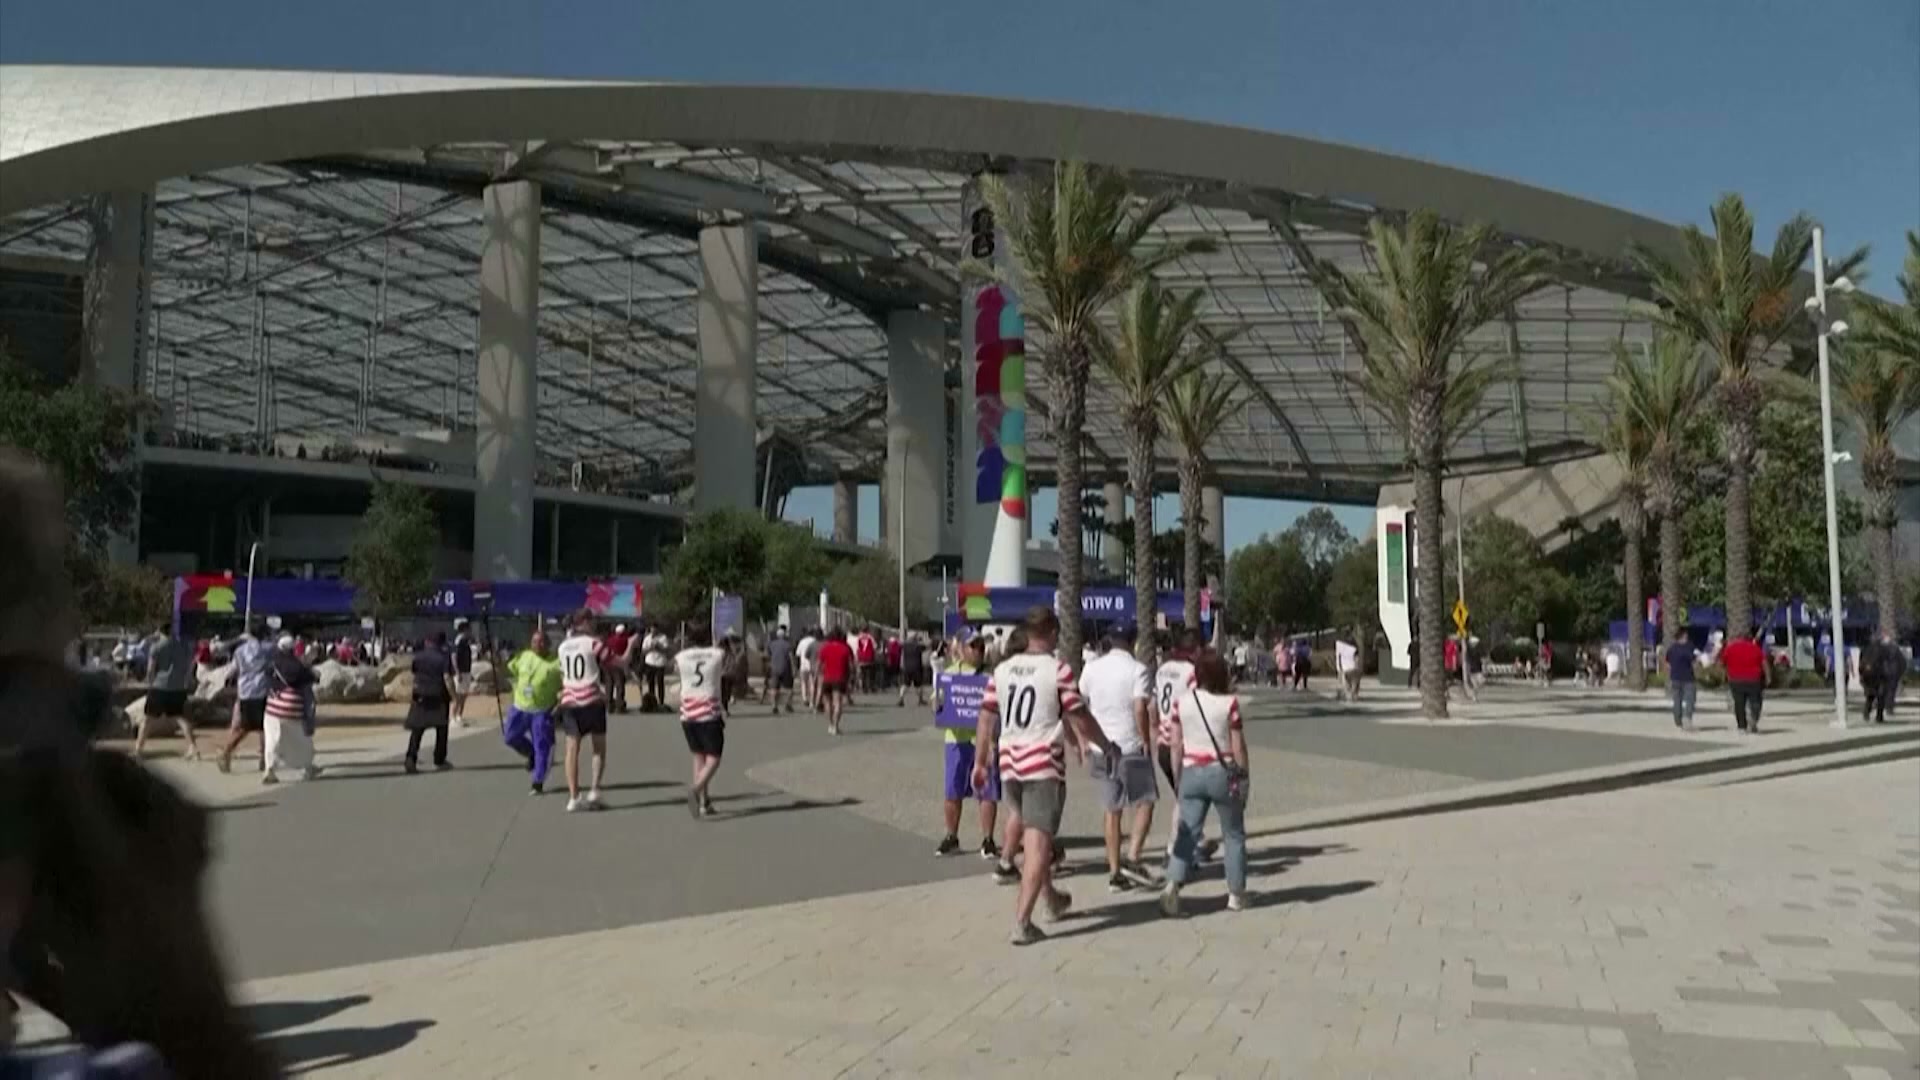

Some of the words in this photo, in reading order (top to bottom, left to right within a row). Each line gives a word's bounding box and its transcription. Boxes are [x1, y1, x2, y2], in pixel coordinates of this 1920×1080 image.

[444, 590, 455, 606] 8
[1081, 595, 1113, 610] NTRY
[565, 653, 586, 681] 10
[691, 660, 706, 687] 5
[1005, 683, 1036, 729] 10
[1161, 682, 1173, 715] 8
